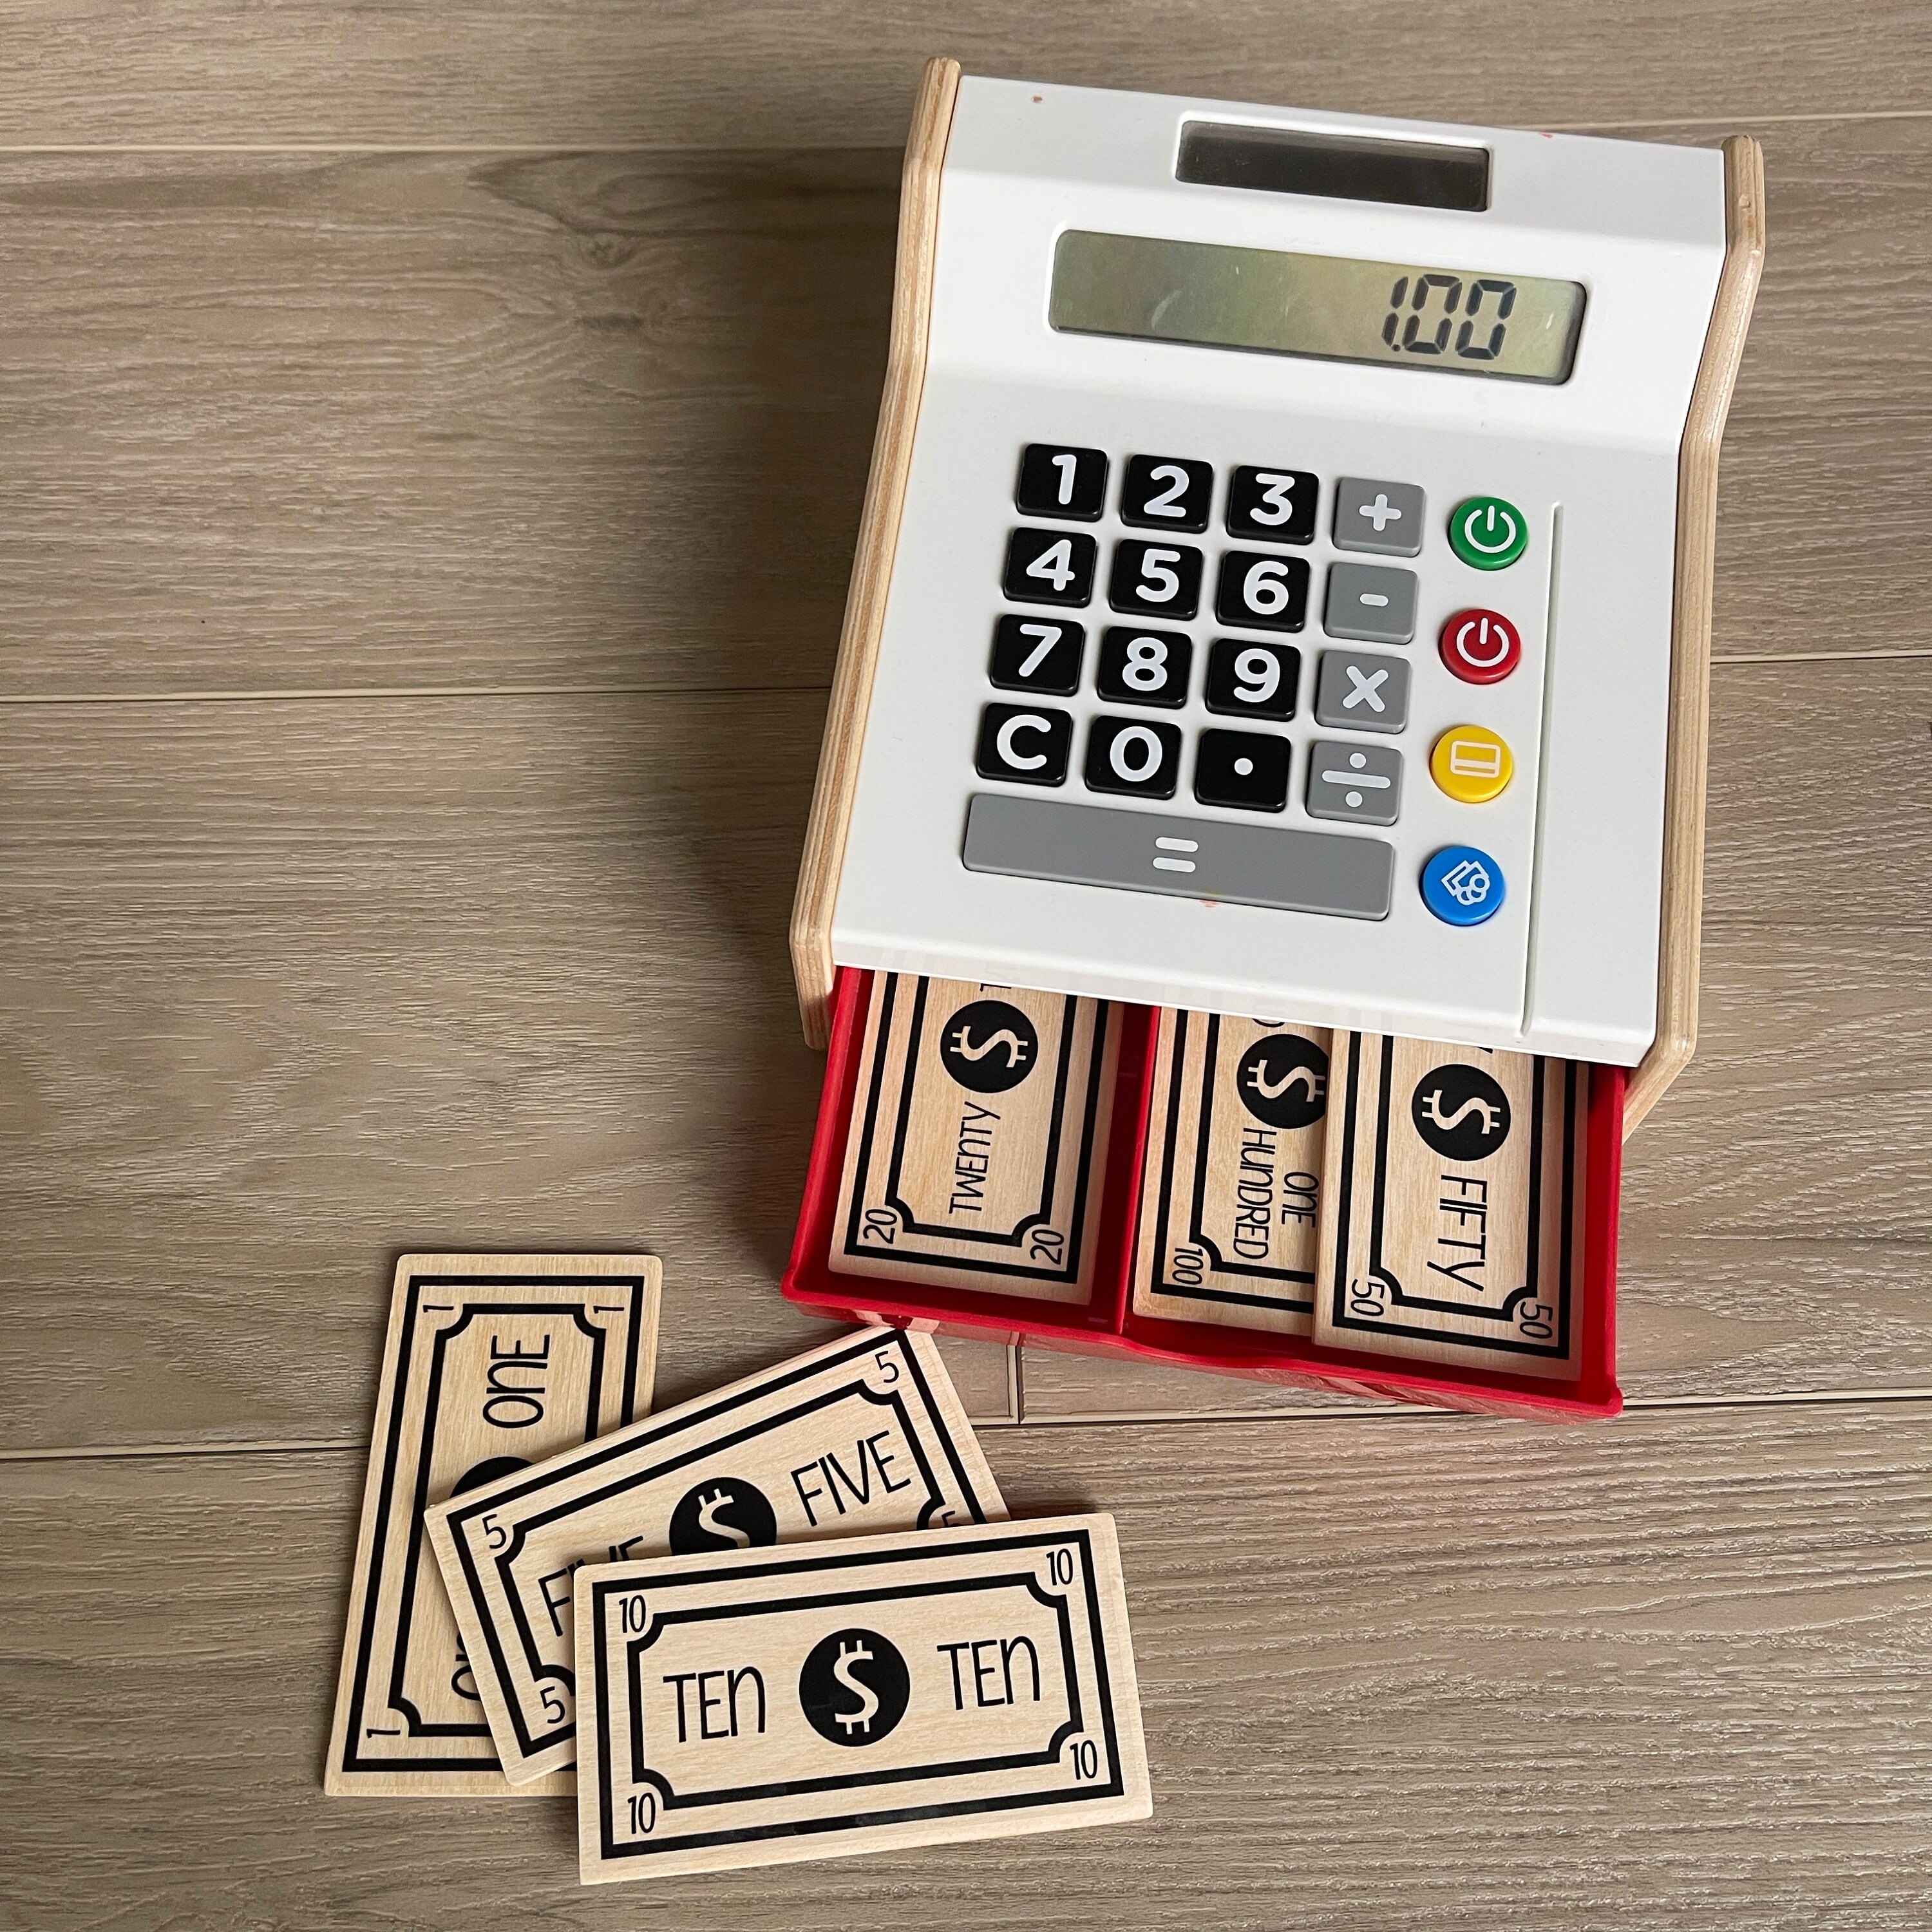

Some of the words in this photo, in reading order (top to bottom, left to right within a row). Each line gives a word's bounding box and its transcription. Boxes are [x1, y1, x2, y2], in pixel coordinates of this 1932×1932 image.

[1382, 274, 1516, 360] 1.00
[1052, 455, 1076, 504] 1
[1144, 466, 1189, 517] 2
[1250, 473, 1294, 525] 3
[1027, 540, 1075, 591] 4
[1136, 549, 1180, 601] 5
[1244, 561, 1289, 614] 6
[1019, 624, 1062, 676] 7
[1122, 638, 1168, 691] 8
[1234, 649, 1280, 702] 9
[997, 715, 1051, 770] C
[951, 1026, 1028, 1067] $
[1247, 1060, 1325, 1103] $
[1422, 1090, 1500, 1133] $
[863, 1209, 897, 1244] 20
[1030, 1229, 1064, 1265] 20
[1427, 1175, 1487, 1291] FIFTY
[1172, 1248, 1204, 1285] 100
[1351, 1279, 1385, 1316] 50
[1519, 1299, 1553, 1340] 50
[875, 1351, 898, 1383] 5
[791, 1430, 911, 1526] FIVE
[482, 1514, 506, 1549] 5
[1046, 1549, 1073, 1586] 10
[619, 1595, 646, 1633] 10
[540, 1686, 565, 1723] 5
[834, 1640, 878, 1734] $
[366, 1729, 400, 1738] 1
[1070, 1740, 1097, 1780] 10
[628, 1793, 656, 1834] 10
